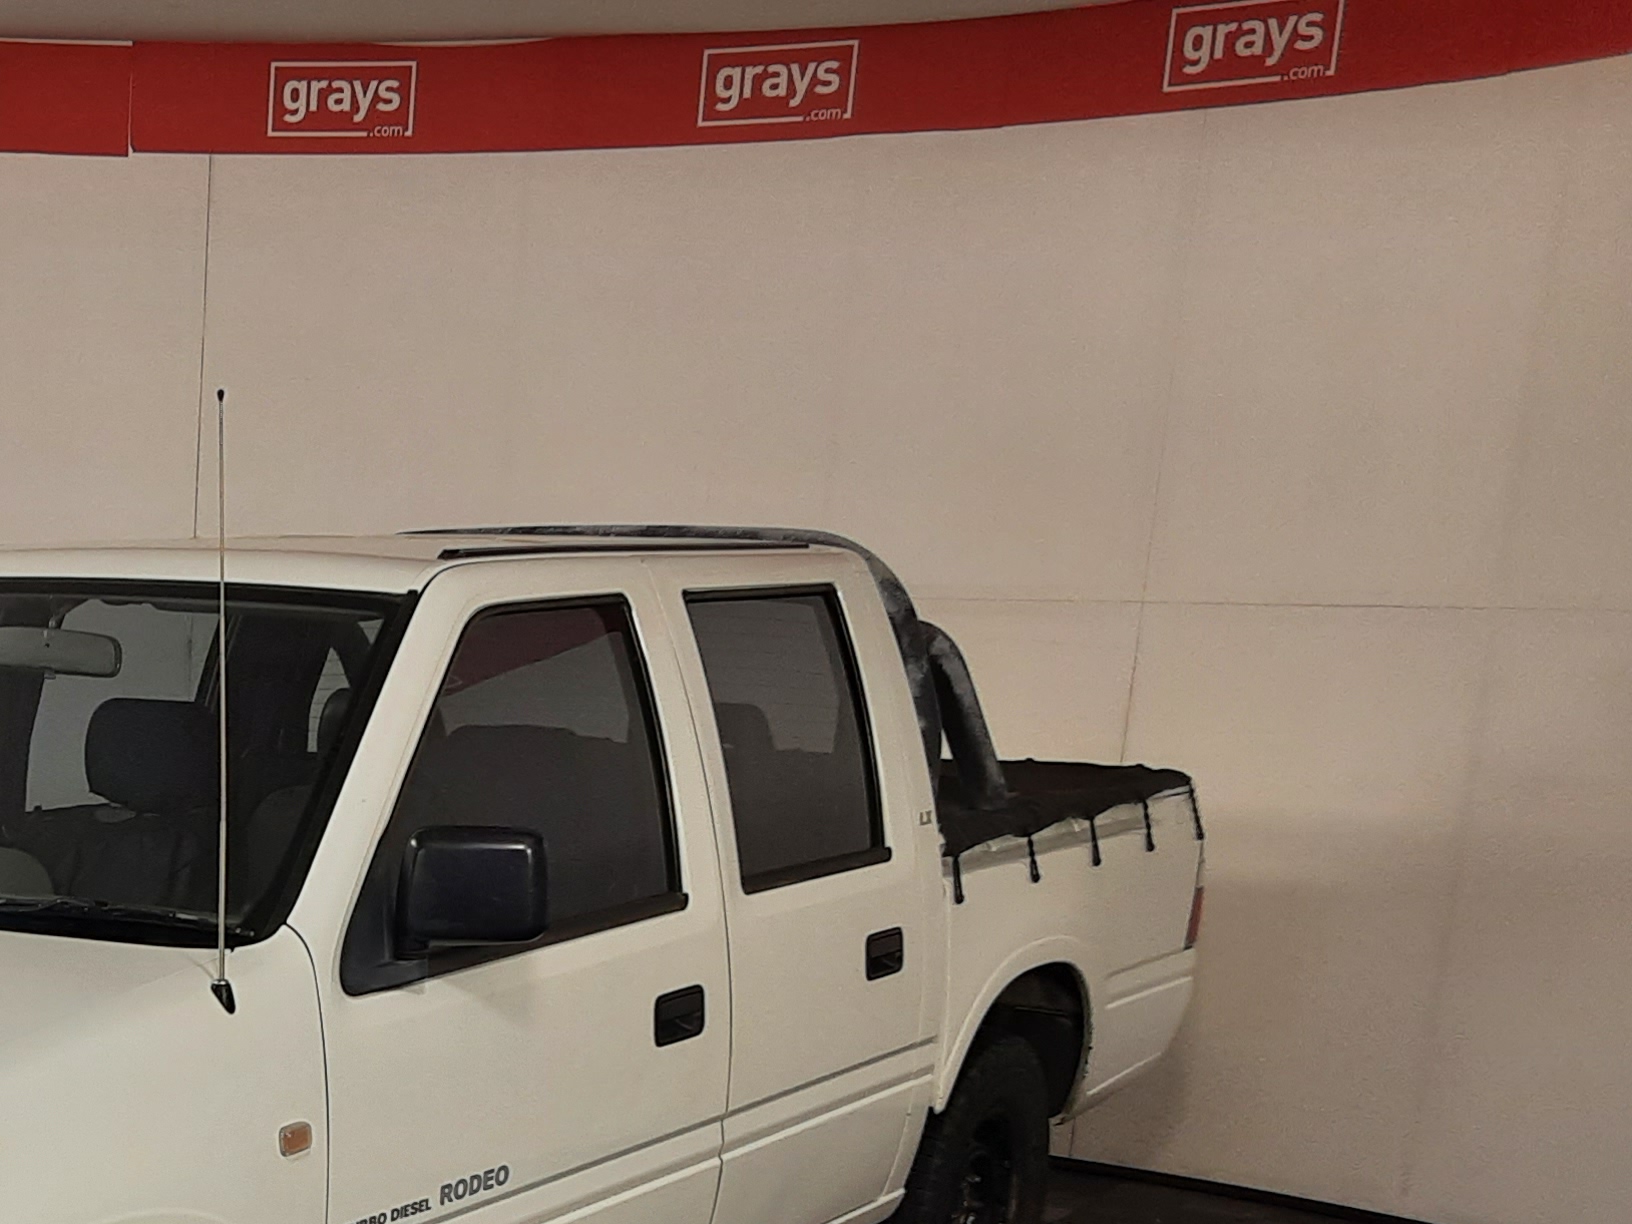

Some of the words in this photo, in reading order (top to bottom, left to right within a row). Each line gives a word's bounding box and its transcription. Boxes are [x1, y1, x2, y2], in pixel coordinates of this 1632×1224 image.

[1181, 12, 1325, 74] grays
[714, 60, 841, 111] grays
[1283, 64, 1324, 81] .com
[282, 79, 401, 123] grays
[805, 108, 842, 122] .com
[369, 125, 403, 137] .com
[390, 1198, 432, 1223] DIESEL
[439, 1165, 510, 1206] RODEO
